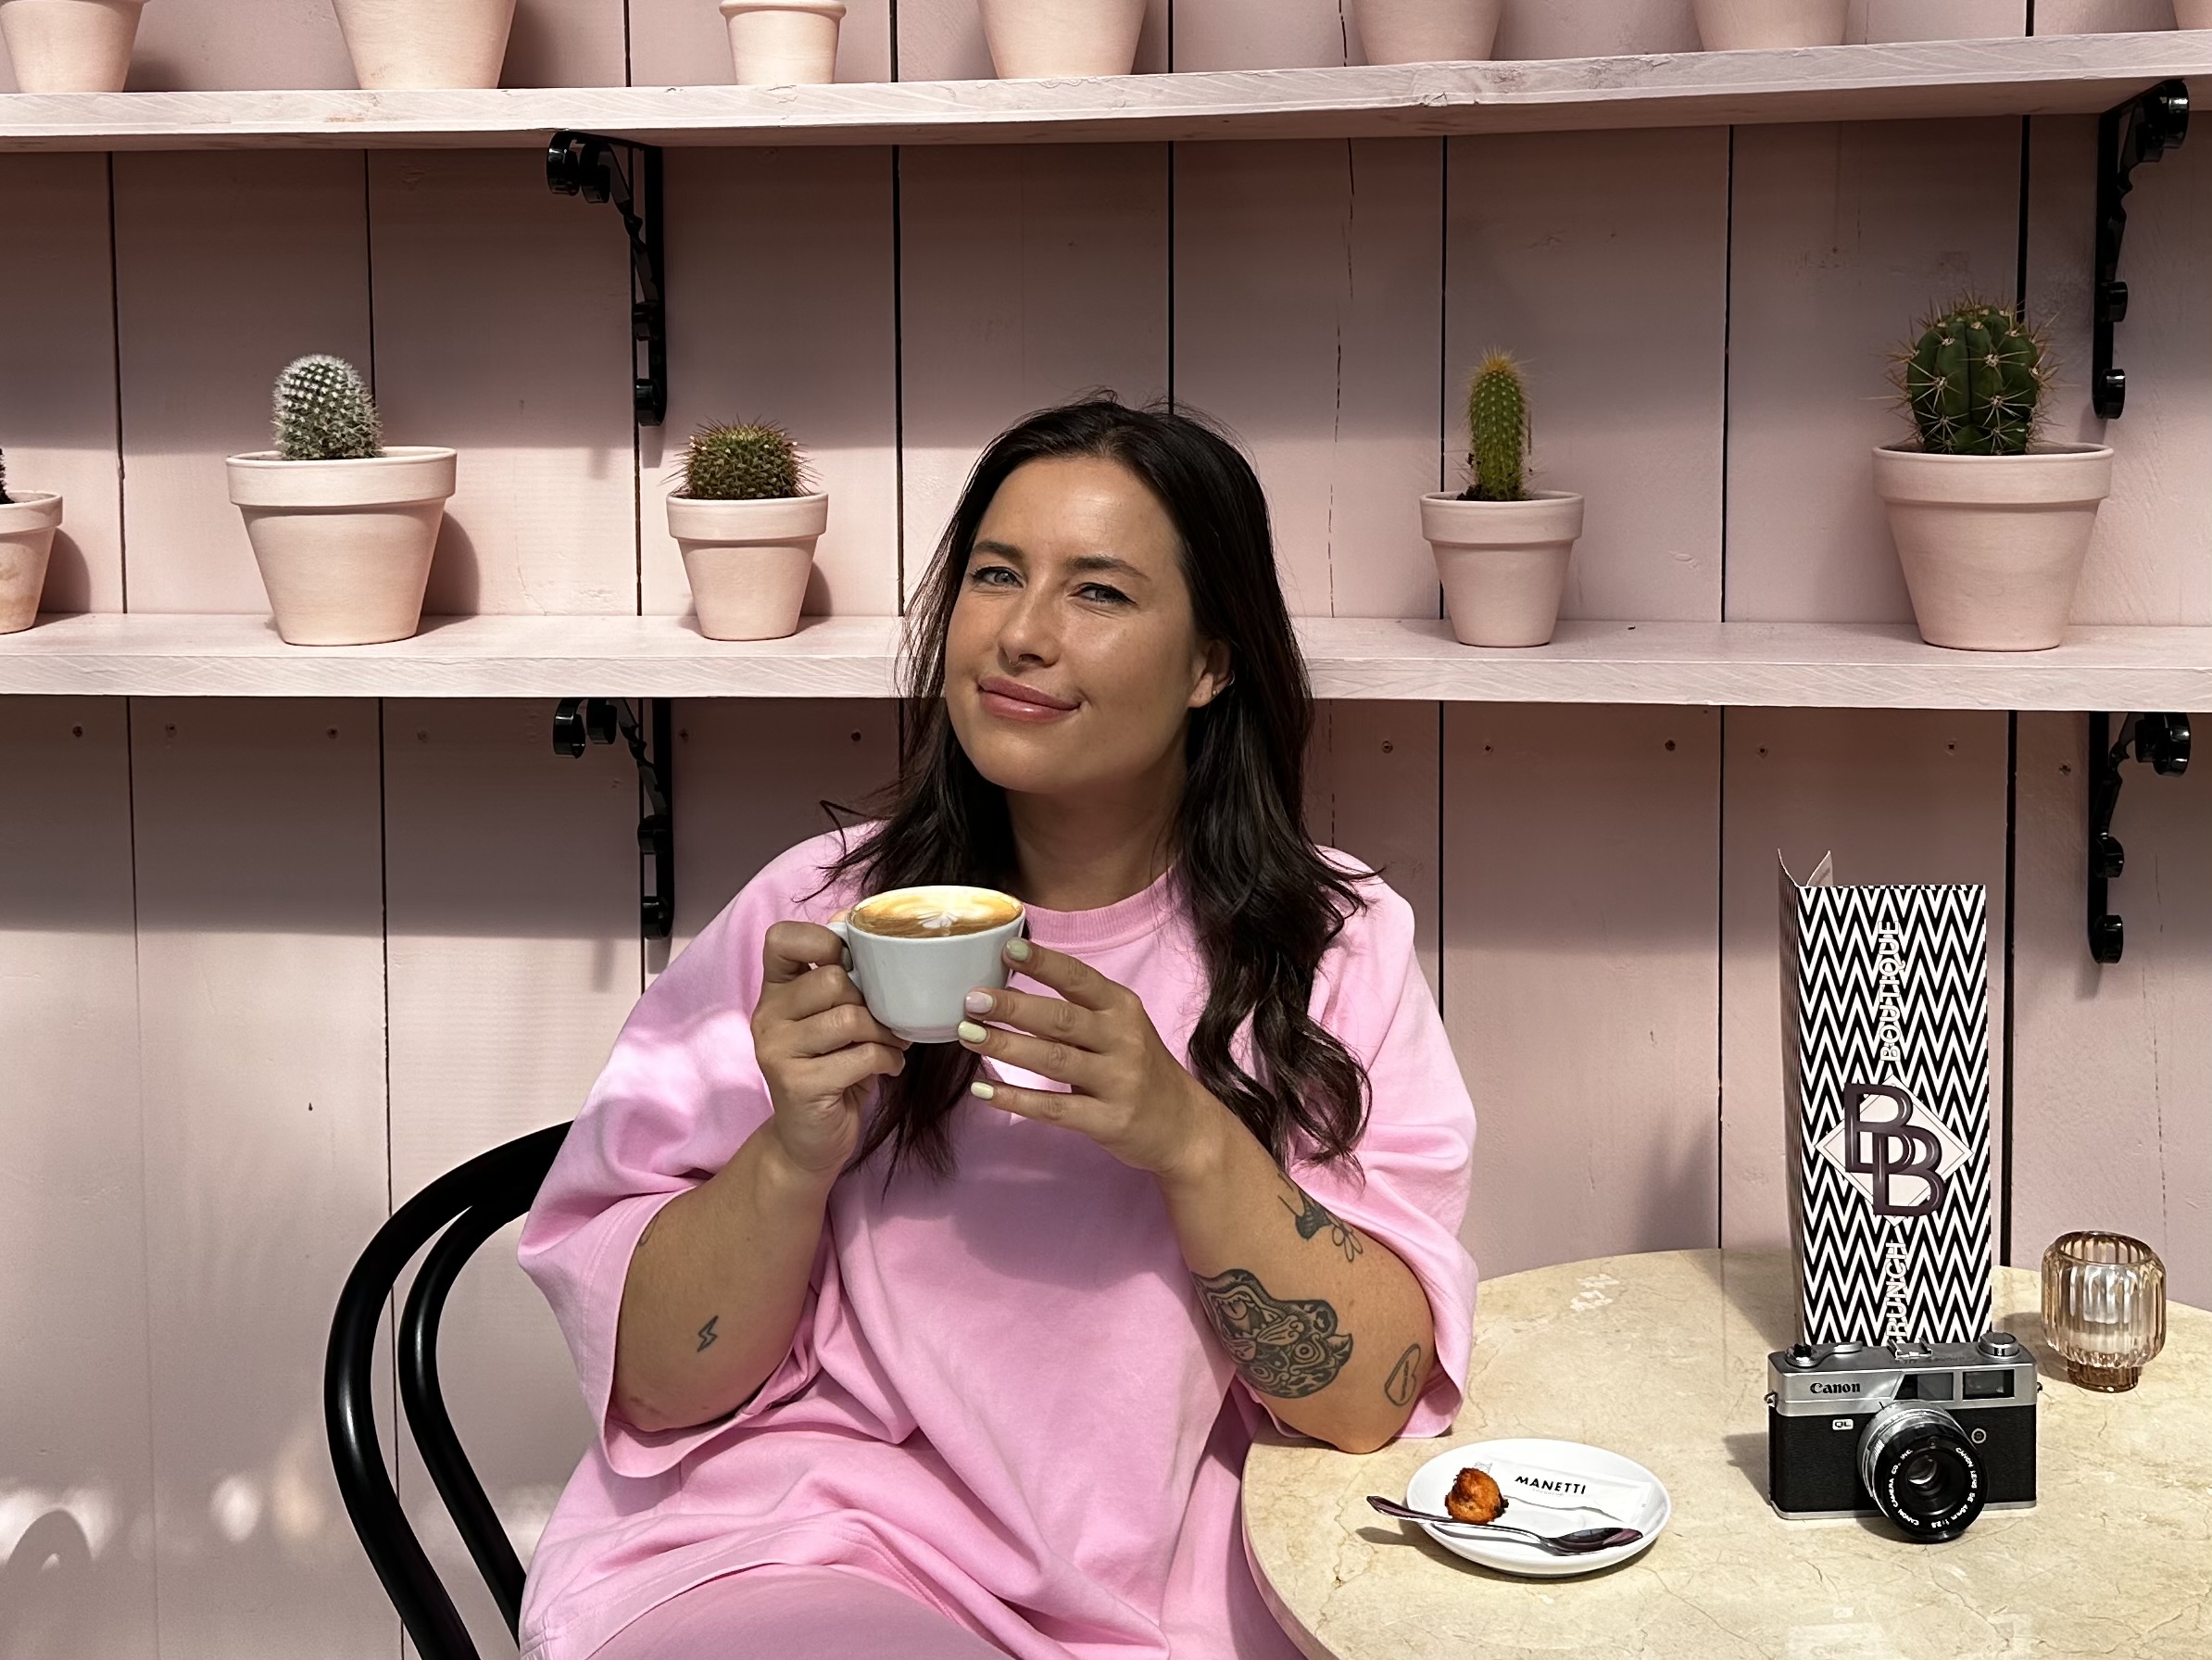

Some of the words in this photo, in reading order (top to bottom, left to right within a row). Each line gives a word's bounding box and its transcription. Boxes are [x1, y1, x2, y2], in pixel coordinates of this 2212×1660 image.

[1878, 921, 1905, 1062] BOUTIQUE
[1885, 1242, 1907, 1339] RUNCH
[1810, 1382, 1861, 1394] Canon
[1954, 1447, 1974, 1467] CANON
[1969, 1470, 1978, 1489] LENS
[1514, 1476, 1587, 1495] MANETTI
[1888, 1478, 1899, 1508] CAMERA
[1897, 1508, 1919, 1526] CANON
